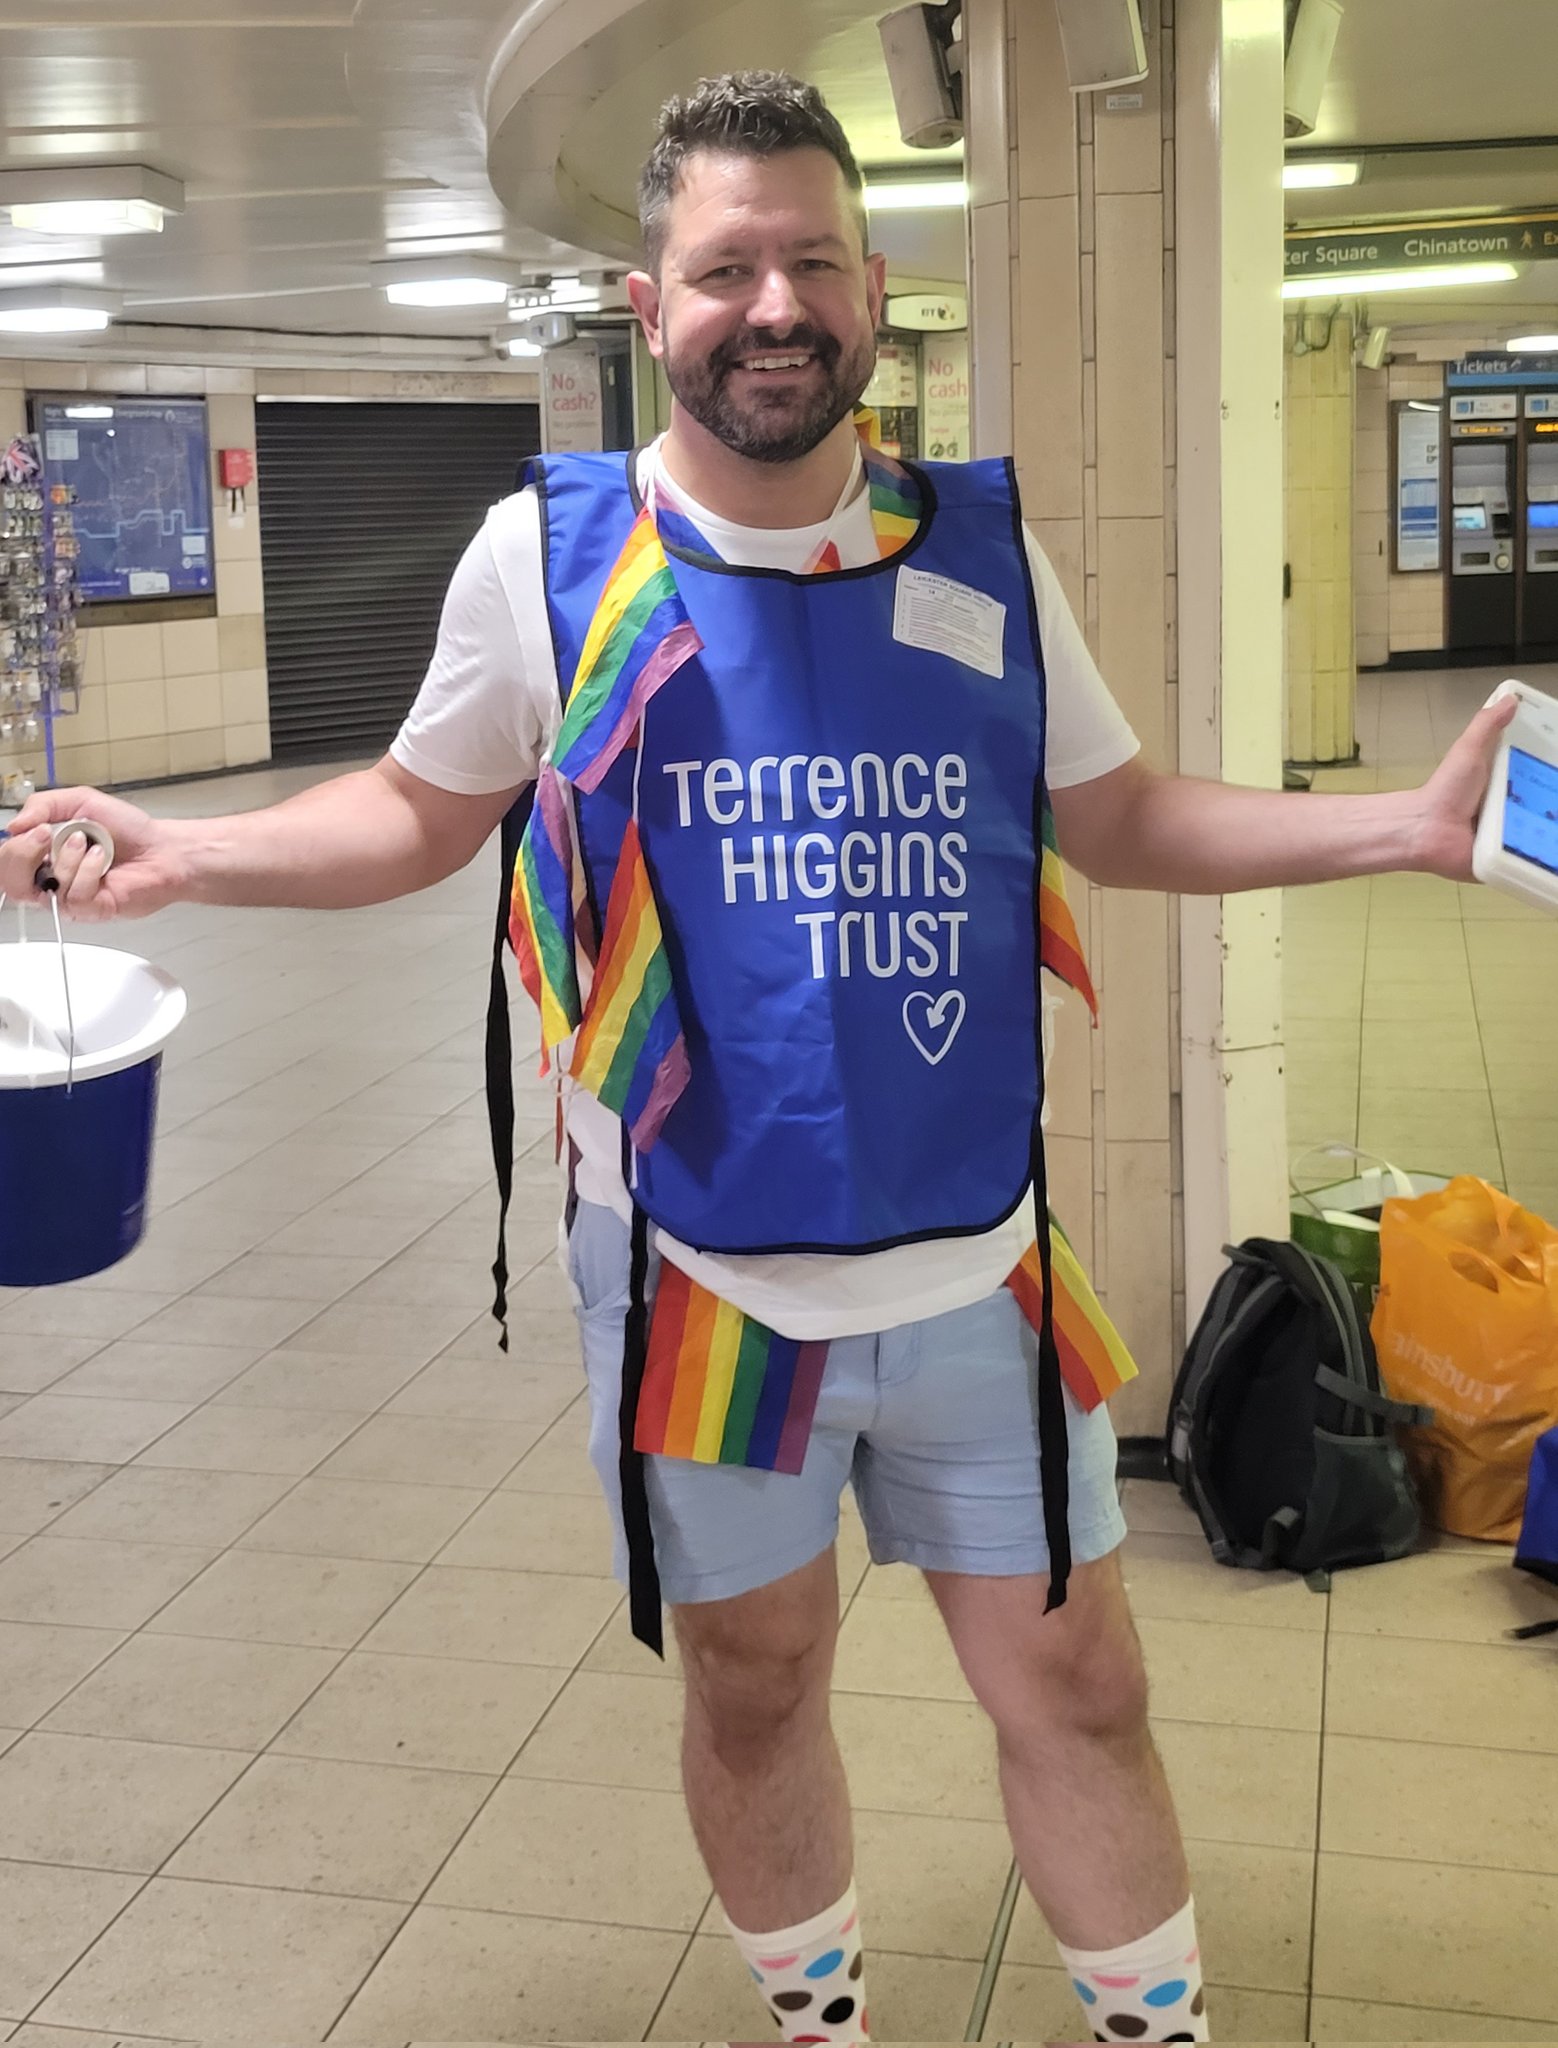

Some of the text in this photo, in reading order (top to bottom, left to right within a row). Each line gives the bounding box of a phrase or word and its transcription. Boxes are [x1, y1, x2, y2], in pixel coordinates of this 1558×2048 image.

[1316, 245, 1378, 265] Square
[1404, 236, 1508, 257] Chinatown
[929, 359, 953, 377] No
[1455, 359, 1507, 374] Tickets
[552, 373, 575, 391] No
[929, 378, 968, 398] cash
[552, 392, 597, 412] cash?
[662, 752, 968, 827] Terrence
